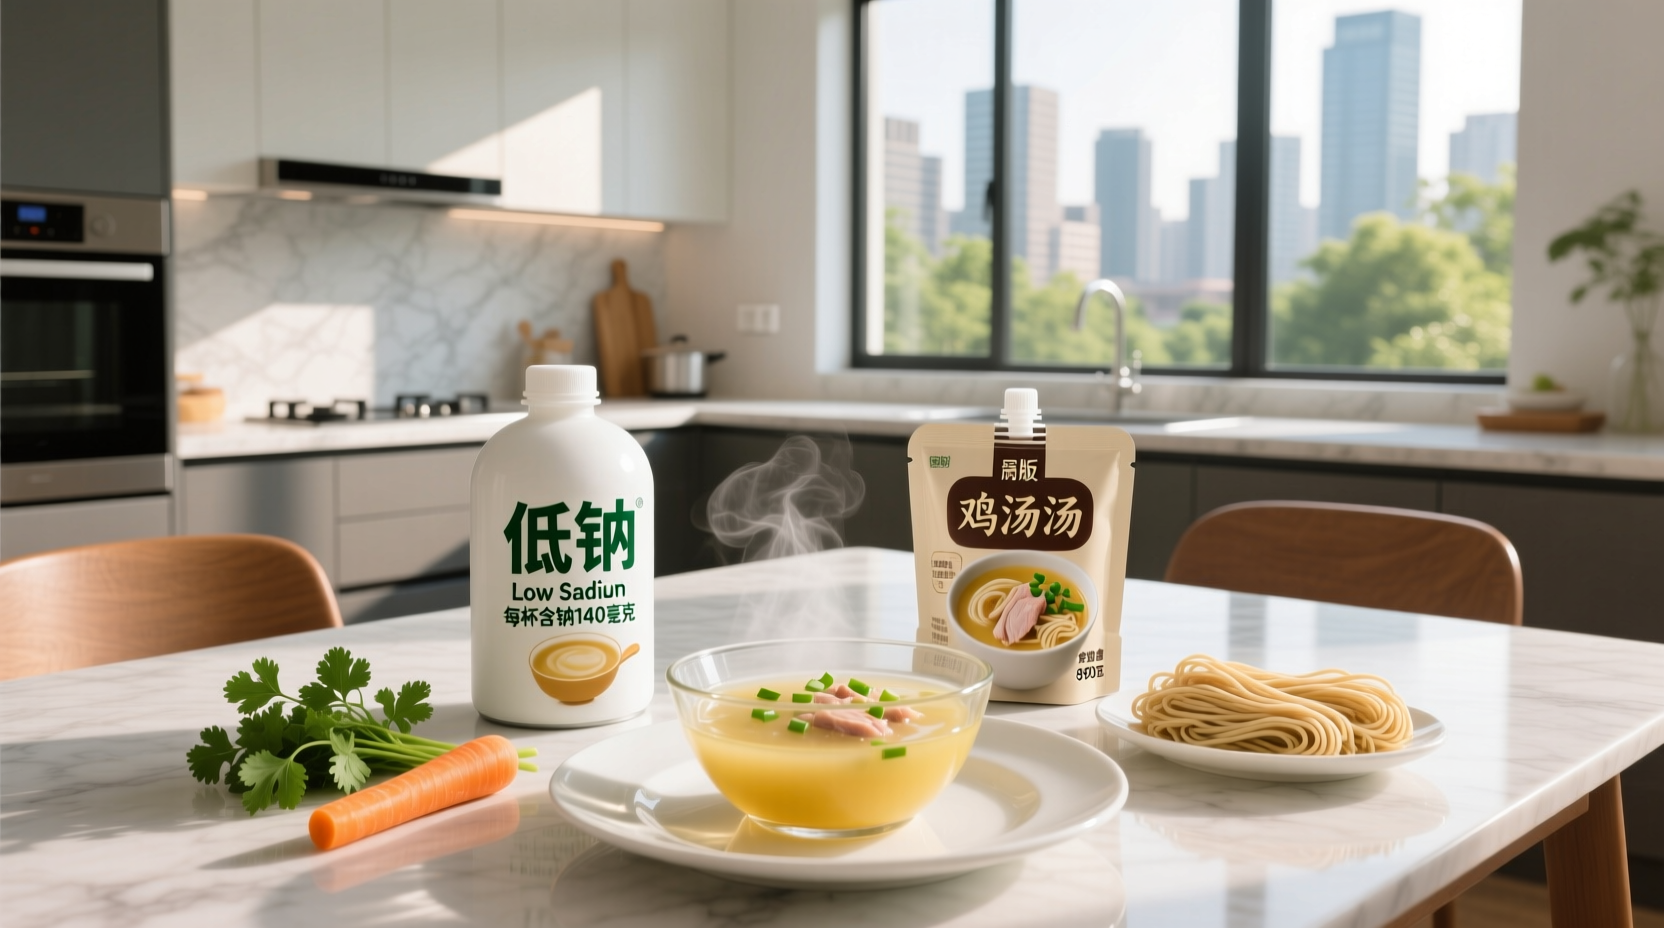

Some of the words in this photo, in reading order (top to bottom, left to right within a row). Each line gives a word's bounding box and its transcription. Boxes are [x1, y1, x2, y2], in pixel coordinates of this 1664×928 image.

[503, 498, 635, 575] 低钠
[957, 491, 1083, 539] 鸡汤汤
[512, 582, 554, 602] Low
[559, 580, 626, 602] Sadiun
